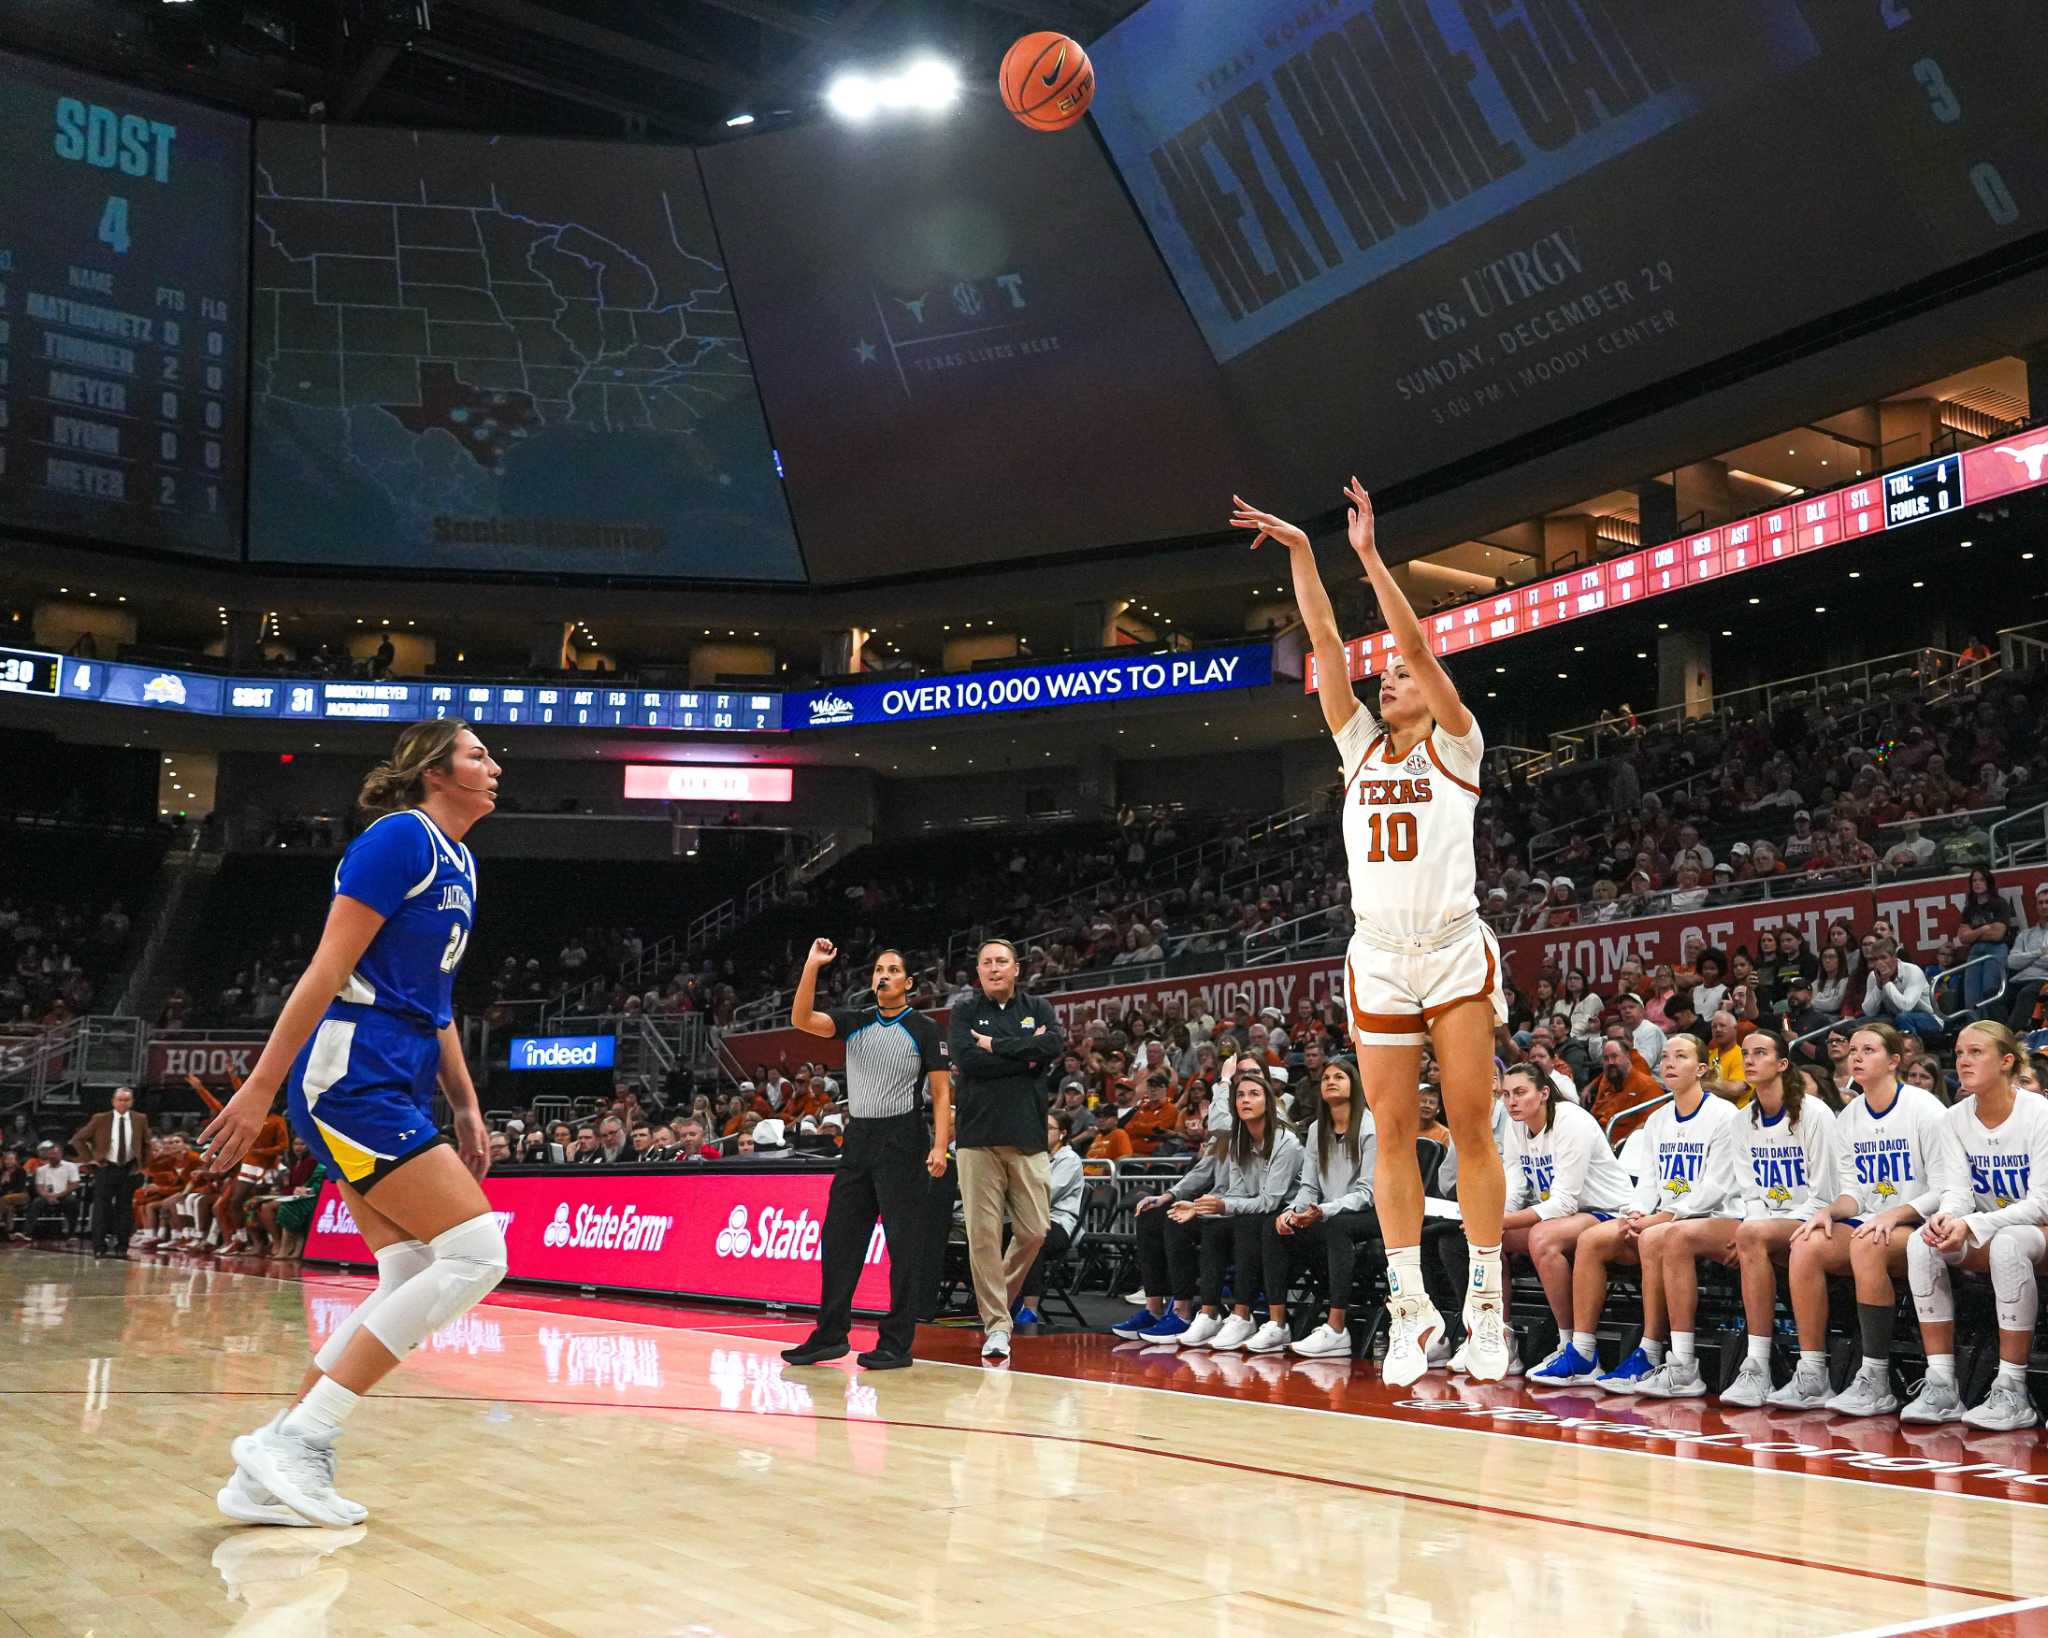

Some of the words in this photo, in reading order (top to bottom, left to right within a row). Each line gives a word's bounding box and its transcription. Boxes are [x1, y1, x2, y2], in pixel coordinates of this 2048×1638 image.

[1911, 57, 1961, 123] 3
[54, 97, 177, 183] SDST
[1149, 80, 1343, 322] NEXT
[1273, 0, 1528, 250] HOME
[1968, 161, 2019, 225] 0
[97, 195, 131, 256] 4
[1460, 224, 1584, 318] UTRGV
[1395, 345, 1496, 401] SUNDAY,
[1499, 281, 1635, 353] DECEMBER
[1641, 260, 1674, 293] 29
[1517, 344, 1594, 385] MOODY
[1596, 309, 1680, 354] CENTER
[162, 356, 179, 380] 2
[160, 477, 176, 505] 2
[1937, 464, 1947, 483] 4
[1807, 501, 1826, 522] BLK
[1851, 489, 1869, 509] STL
[1890, 496, 1930, 522] FOULS:
[1938, 490, 1949, 510] 0
[74, 665, 91, 691] 4
[882, 687, 951, 715] OVER
[955, 675, 1040, 710] 10,000
[1044, 666, 1122, 700] WAYS
[1126, 664, 1166, 691] TO
[1171, 656, 1241, 687] PLAY
[291, 687, 314, 712] 31
[437, 706, 446, 720] 2
[474, 707, 483, 721] 0
[510, 708, 518, 722] 0
[544, 709, 552, 723] 0
[579, 710, 587, 723] 0
[615, 711, 621, 725] 1
[648, 711, 657, 726] 0
[684, 713, 693, 727] 0
[714, 714, 732, 728] 0-0
[757, 715, 765, 729] 2
[574, 691, 593, 705] AST
[717, 696, 730, 709] FT
[1359, 779, 1433, 805] TEXAS
[1367, 811, 1419, 862] 10
[1545, 931, 1660, 984] HOME
[1680, 921, 1734, 972] OF
[1157, 989, 1190, 1021] TO
[1199, 974, 1297, 1020] MOODY
[166, 1049, 252, 1075] HOOK
[522, 1040, 598, 1066] indeed
[1753, 1159, 1809, 1188] STATE
[751, 1206, 822, 1261] State
